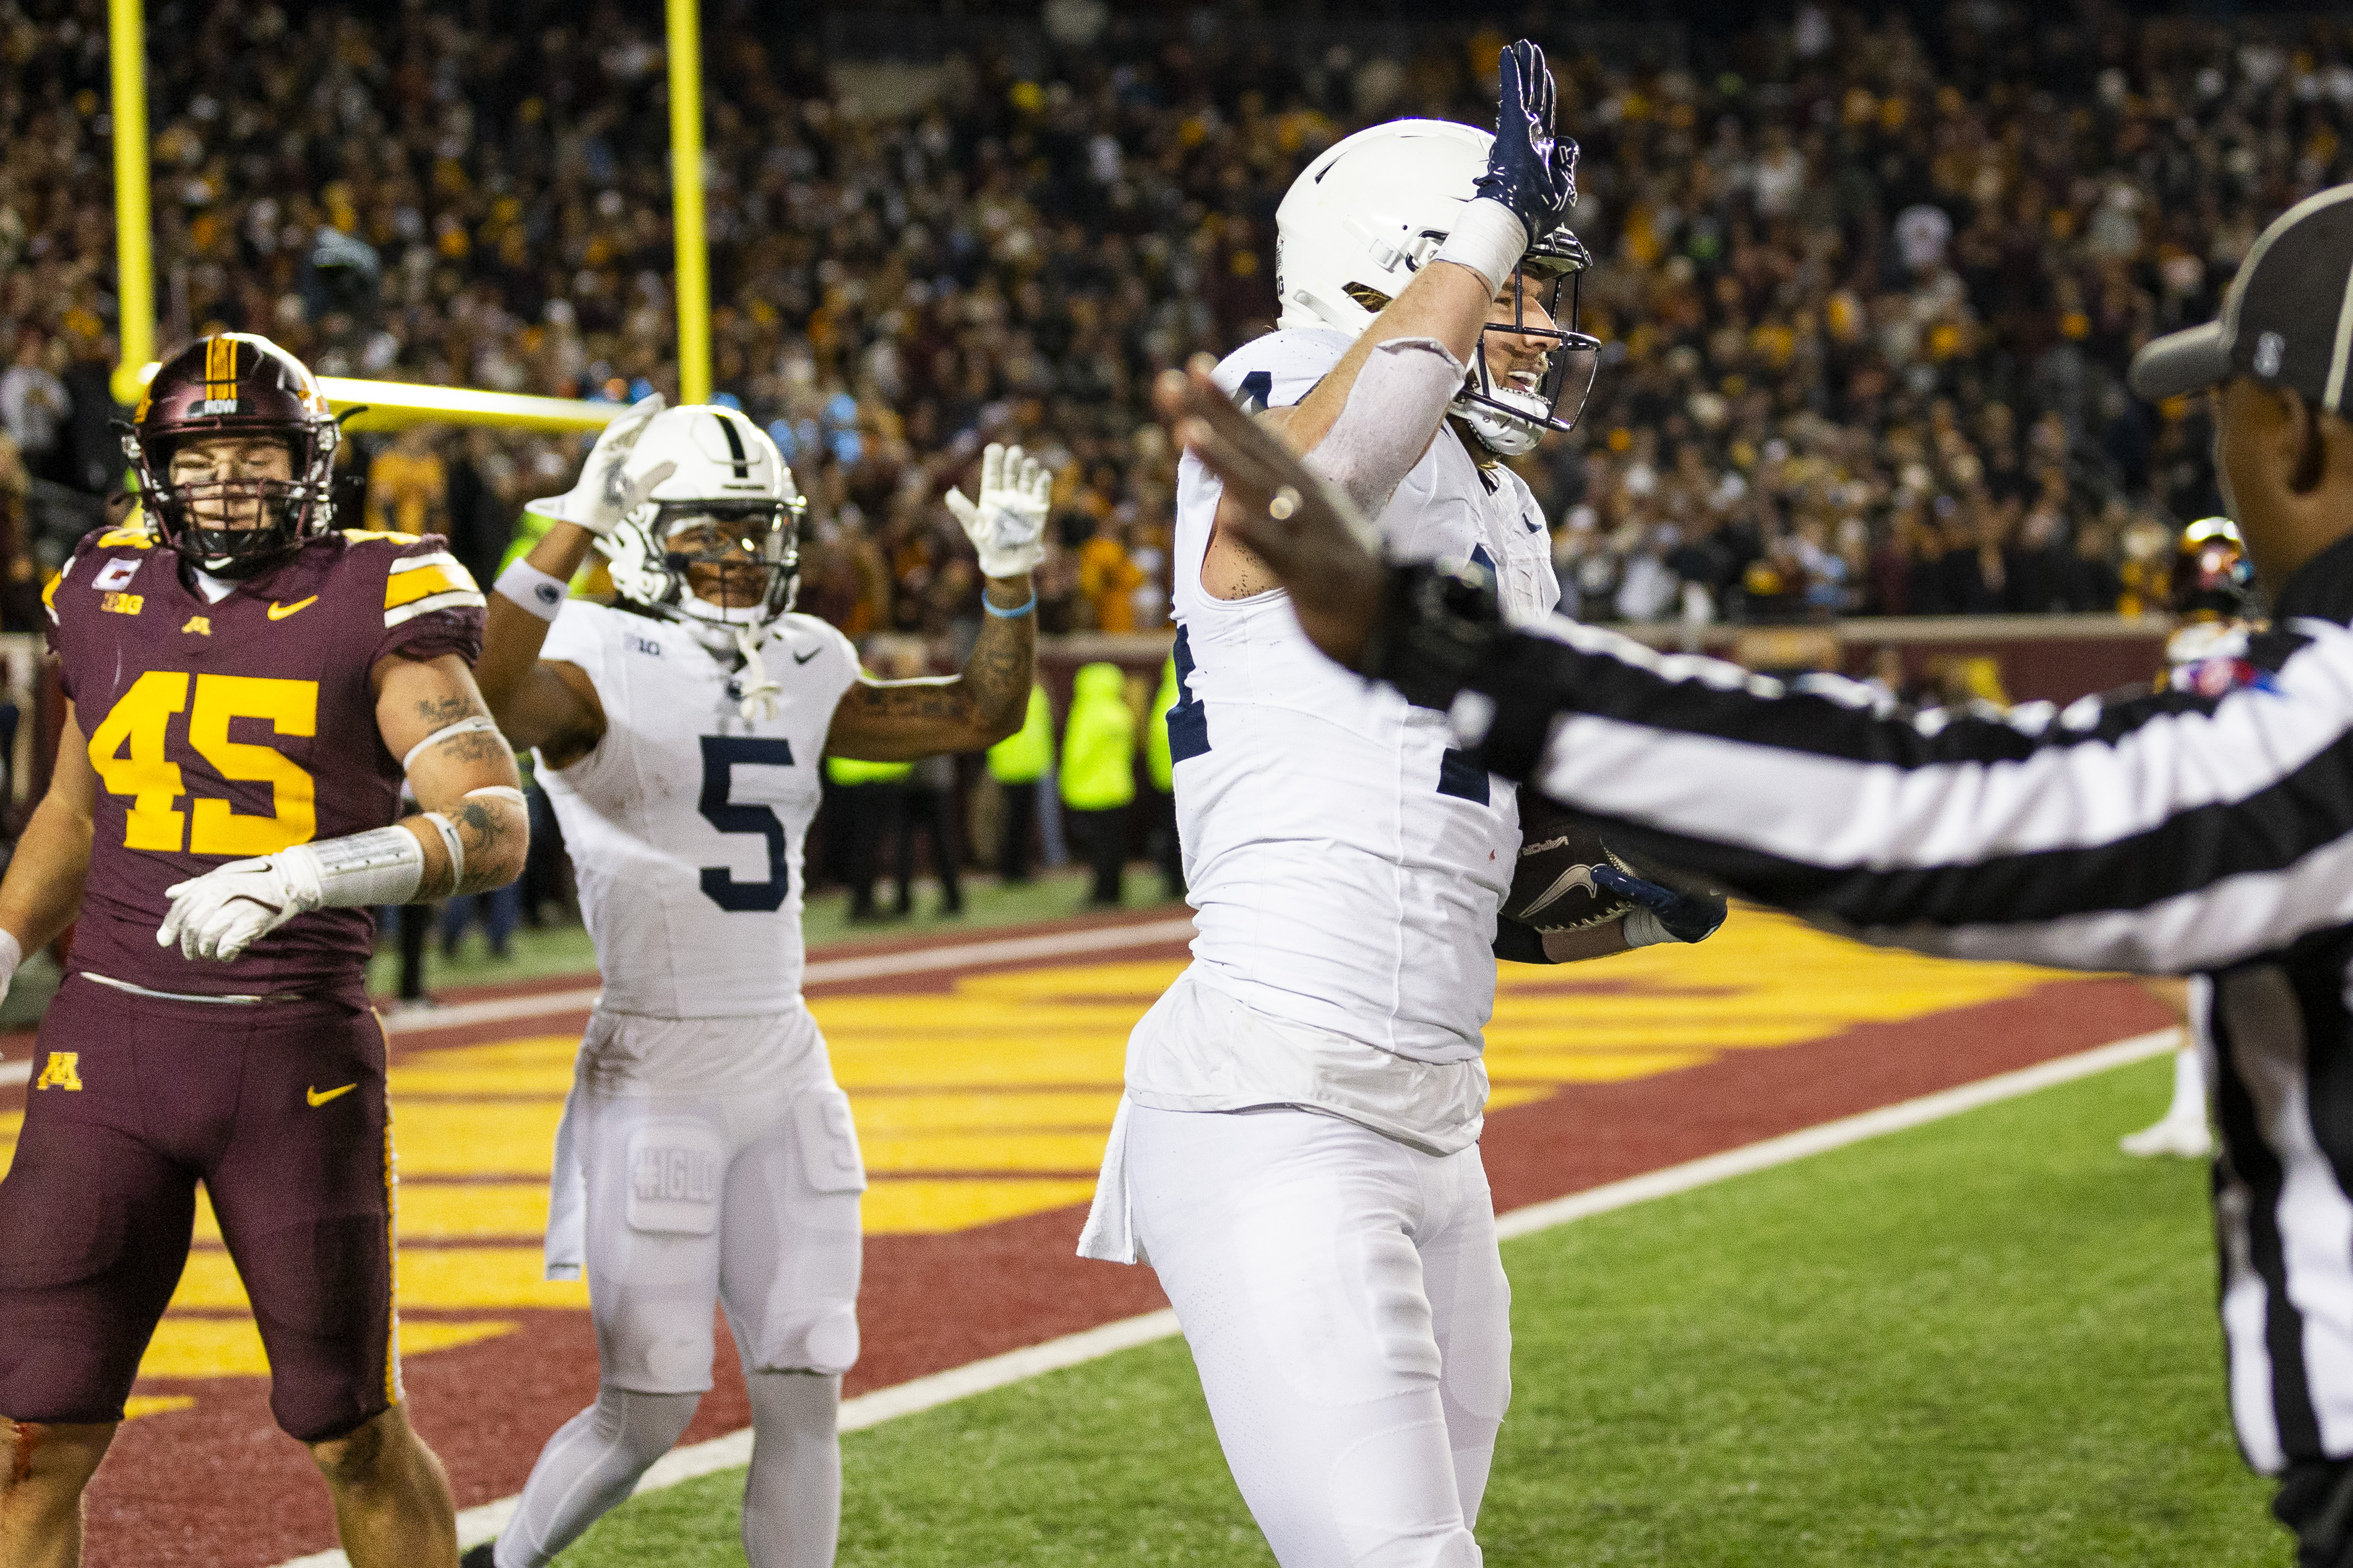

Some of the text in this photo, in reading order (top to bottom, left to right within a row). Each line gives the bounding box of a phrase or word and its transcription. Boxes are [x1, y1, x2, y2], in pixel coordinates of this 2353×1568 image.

[204, 400, 238, 415] ROW
[88, 671, 319, 856] 45
[699, 735, 794, 912] 5
